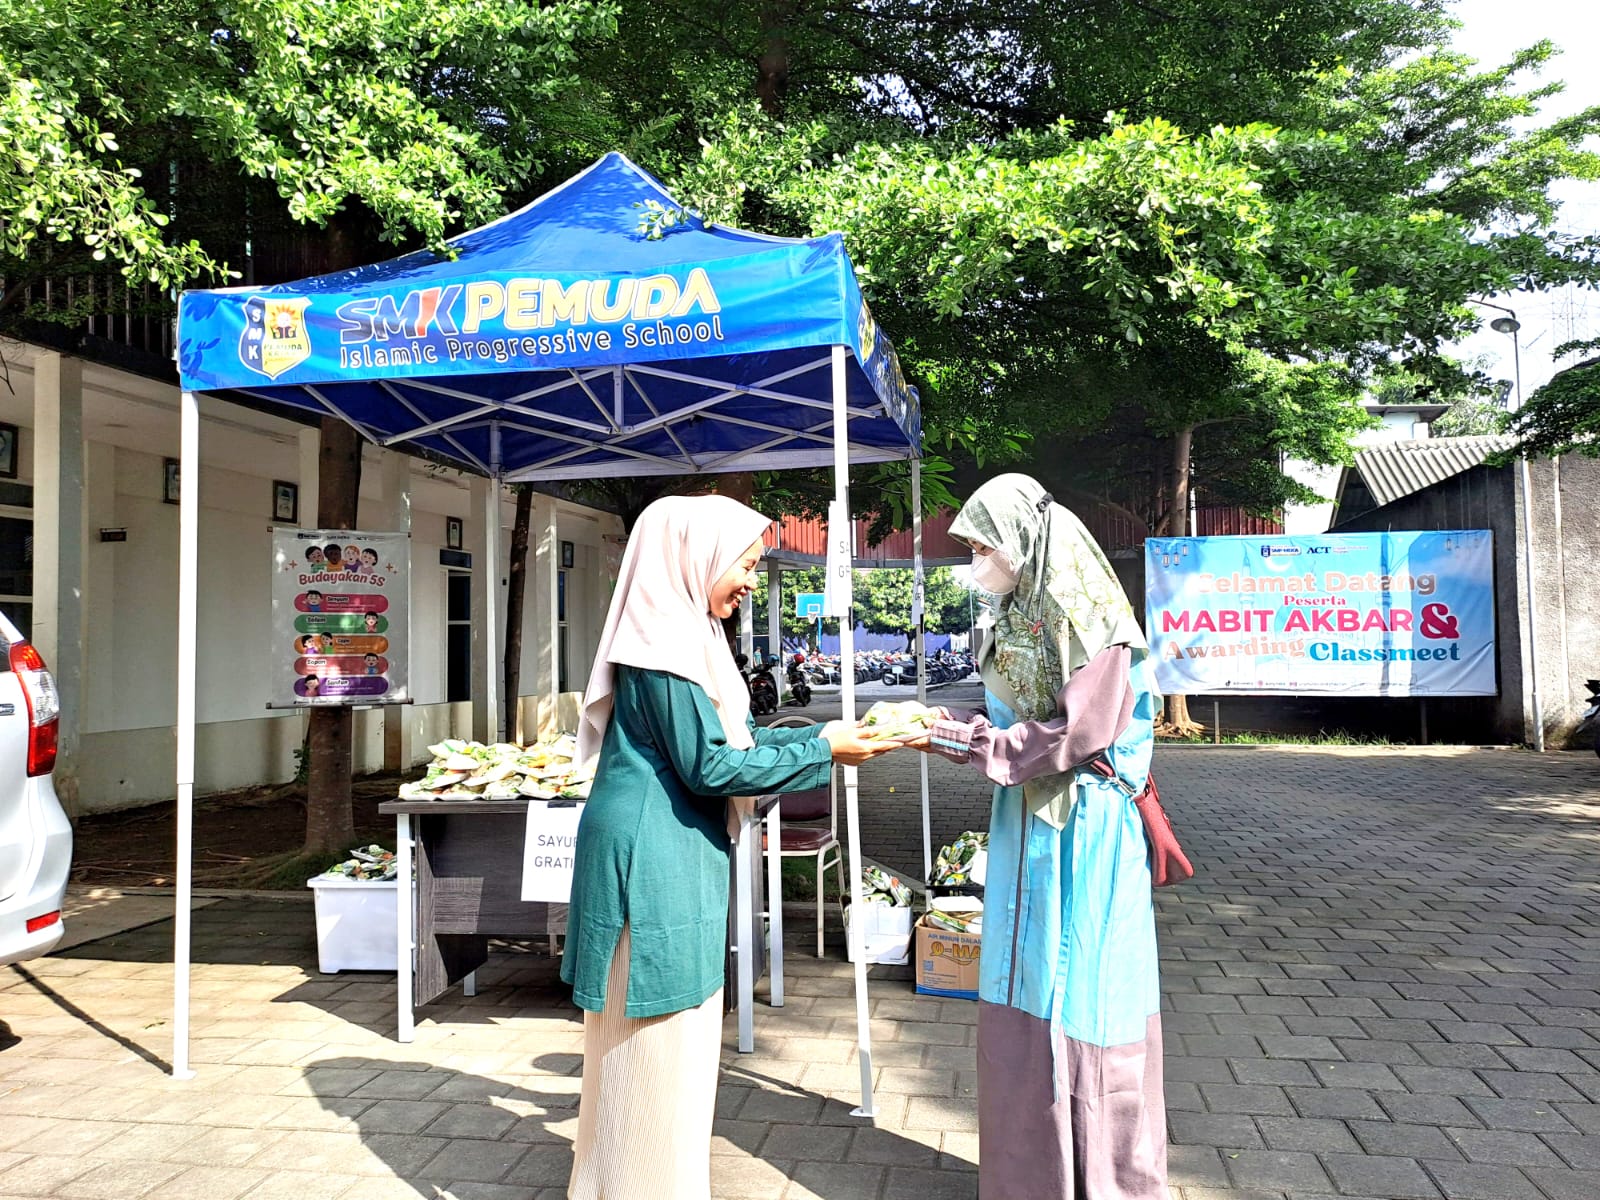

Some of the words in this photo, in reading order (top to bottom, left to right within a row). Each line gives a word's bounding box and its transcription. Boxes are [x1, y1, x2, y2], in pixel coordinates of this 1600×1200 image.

[337, 285, 463, 343] SMK
[462, 267, 721, 334] PEMUDA
[341, 343, 437, 368] Islamic
[447, 328, 611, 362] Progressive
[623, 314, 724, 348] School
[1306, 546, 1332, 554] ACT
[299, 571, 367, 585] Budayakan
[369, 574, 386, 587] 5S
[1326, 573, 1436, 595] Datang
[1284, 595, 1346, 606] Peserta
[1162, 609, 1274, 632] MABIT
[1284, 609, 1413, 632] AKBAR
[1420, 603, 1460, 639] &
[1164, 636, 1306, 660] Awarding
[1309, 642, 1461, 661] Classmeet
